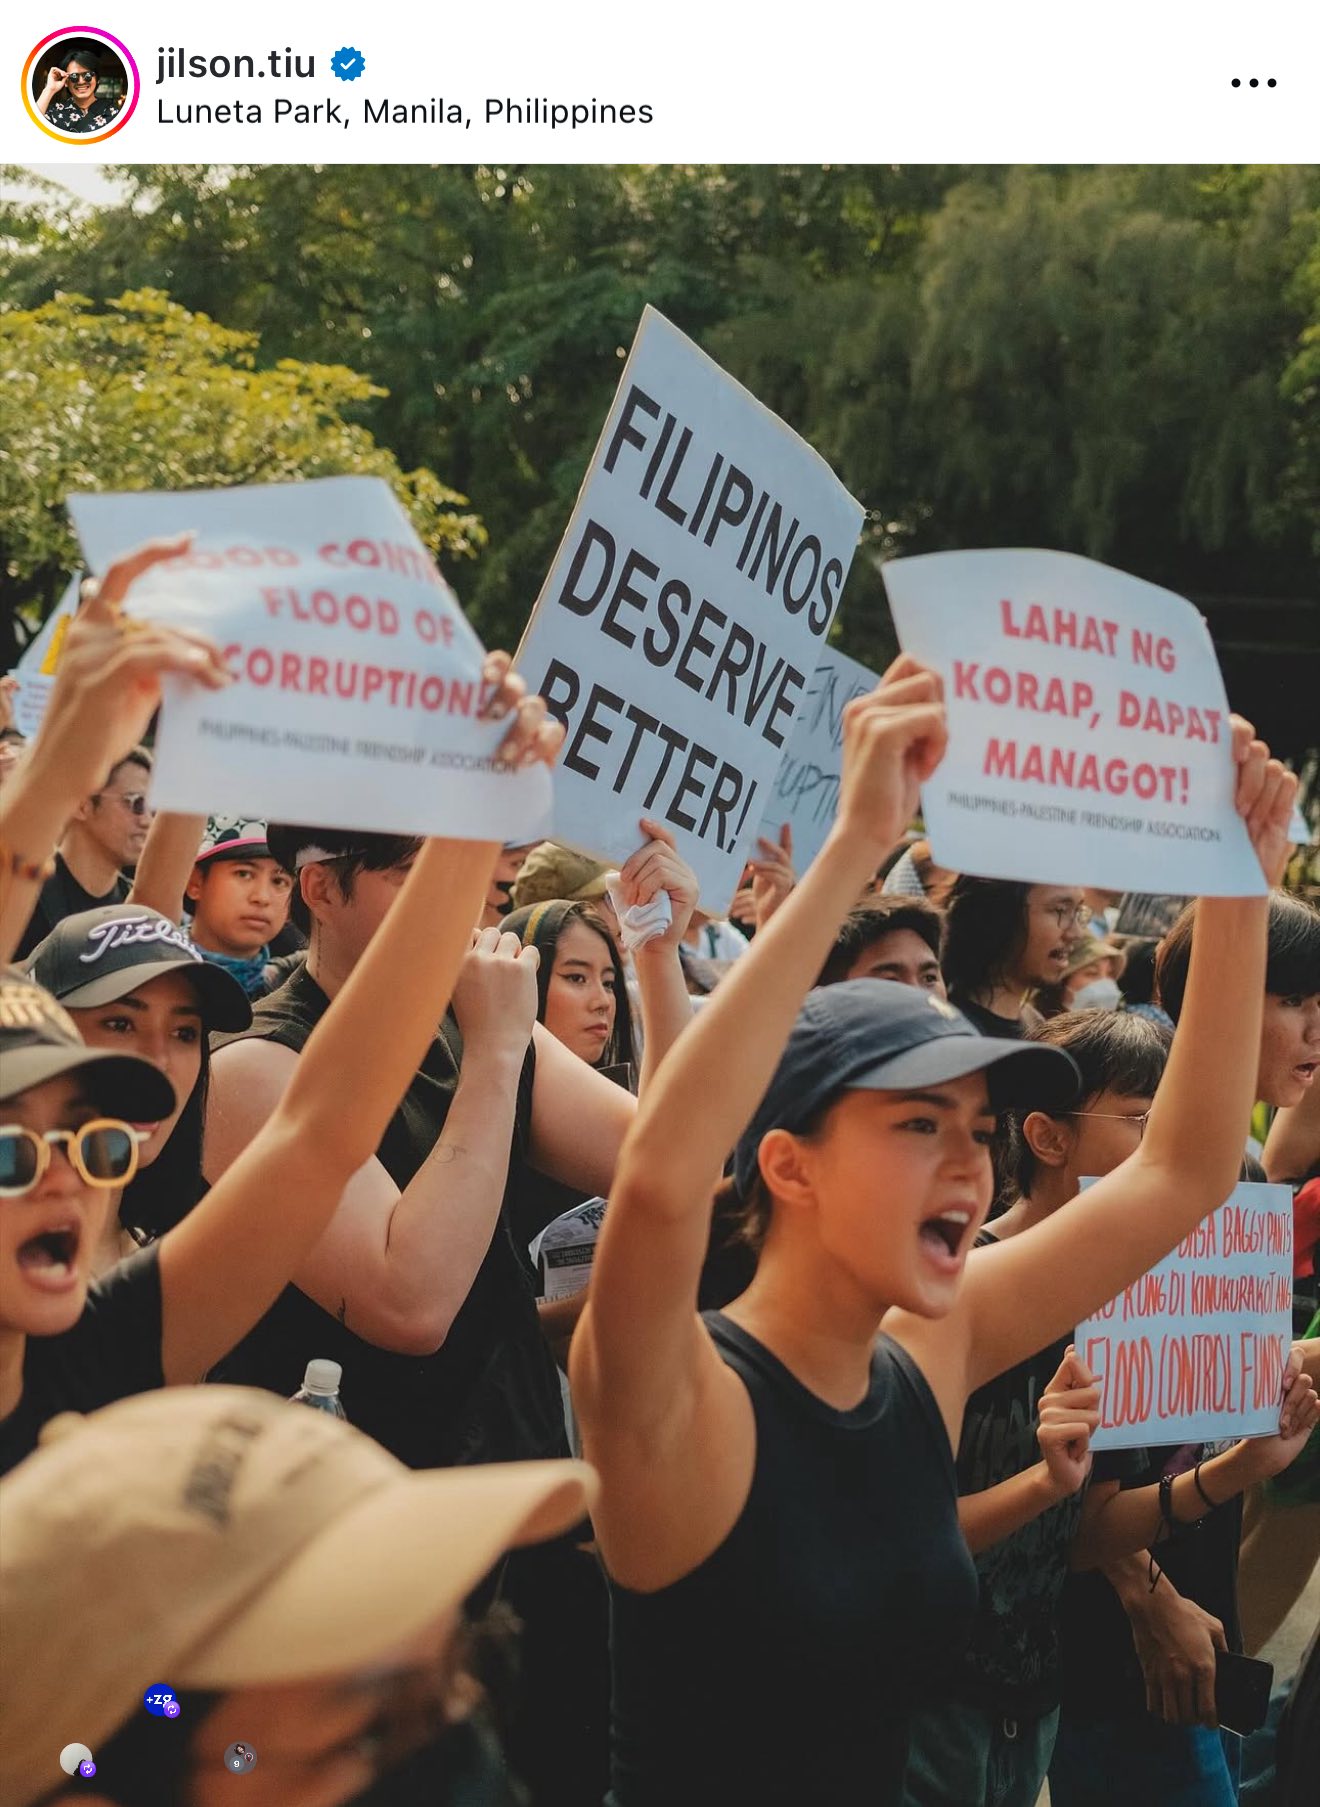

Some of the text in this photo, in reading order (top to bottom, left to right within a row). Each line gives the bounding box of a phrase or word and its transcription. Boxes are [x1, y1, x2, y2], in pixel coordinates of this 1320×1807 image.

[602, 384, 843, 636] FILIPINOS
[260, 585, 455, 647] FLOOD OF
[558, 518, 805, 749] DESERVE
[999, 598, 1177, 674] LAHAT NG
[952, 660, 1221, 744] KORAP, DAPAT
[537, 658, 758, 854] BETTER!
[982, 738, 1190, 805] MANAGOT!
[1080, 811, 1142, 834] FRIENDSHIP
[1147, 819, 1221, 843] ASSOCIATION
[1223, 1206, 1266, 1259] BAGGY
[1266, 1210, 1291, 1257] PANTS
[1122, 1274, 1166, 1322] KUNG
[1168, 1269, 1186, 1317] DI
[1276, 1275, 1291, 1313] ANG
[1086, 1335, 1154, 1429] FLOOD
[1157, 1333, 1236, 1419] CONTROL
